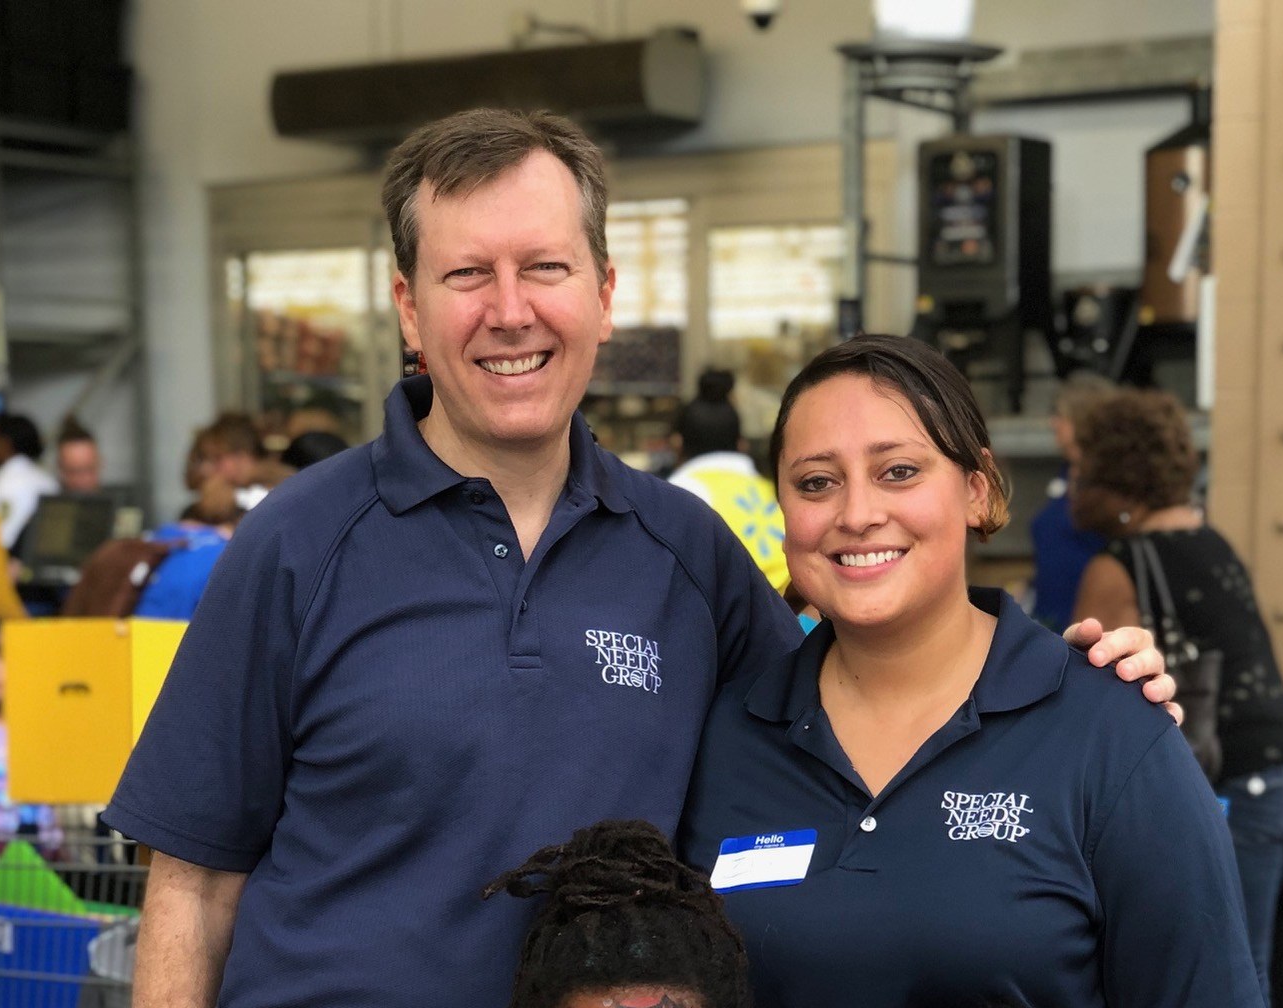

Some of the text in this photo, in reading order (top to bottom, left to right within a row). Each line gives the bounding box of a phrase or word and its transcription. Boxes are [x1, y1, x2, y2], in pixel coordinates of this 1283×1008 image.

[585, 629, 662, 661] SPECIAL
[595, 645, 658, 675] NEEDS
[601, 664, 662, 694] GROUP
[941, 790, 1034, 813] SPECIAL
[944, 806, 1020, 826] NEEDS
[755, 834, 784, 845] Hello
